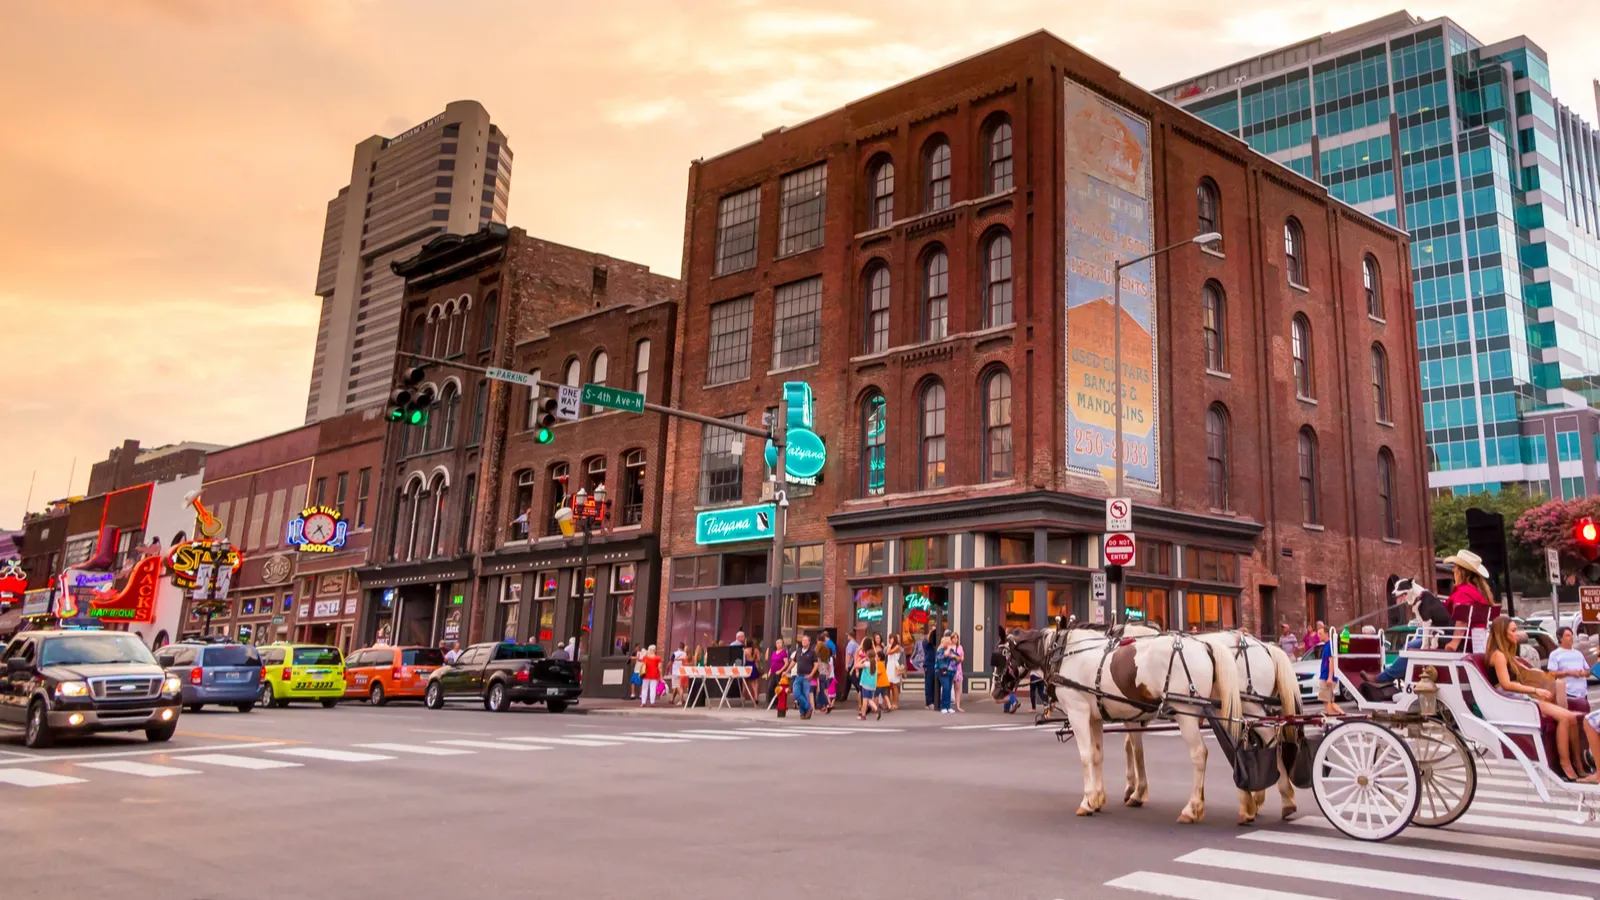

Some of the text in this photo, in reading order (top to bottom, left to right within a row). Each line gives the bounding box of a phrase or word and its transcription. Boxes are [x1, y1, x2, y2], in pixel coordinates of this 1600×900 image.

[1071, 346, 1101, 369] USED
[1103, 356, 1150, 384] GUTARS
[496, 370, 528, 383] PARKING
[562, 388, 578, 397] ONE
[585, 389, 642, 408] S-4th Ave-N
[561, 396, 577, 406] WAY
[785, 441, 826, 459] Tatyana
[302, 506, 341, 519] BIG TIME
[704, 517, 751, 535] Tatyana
[300, 544, 335, 552] BOOTS
[135, 561, 155, 620] JACKS
